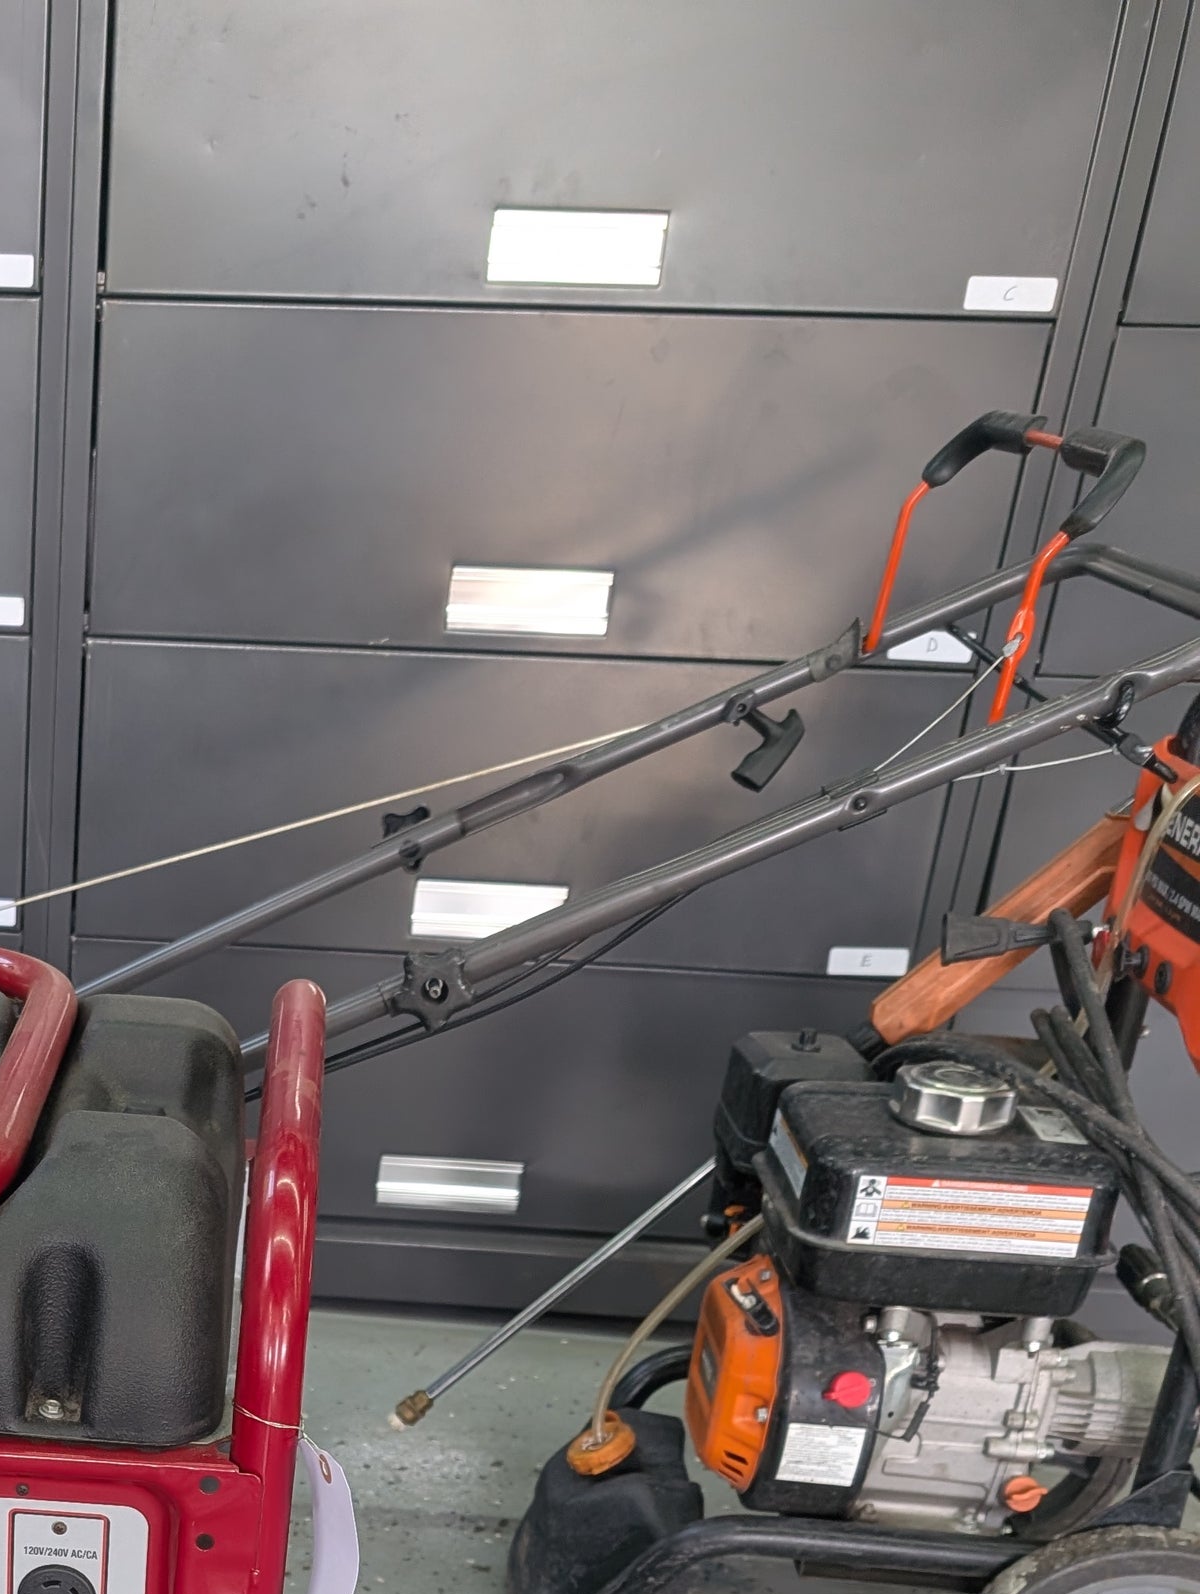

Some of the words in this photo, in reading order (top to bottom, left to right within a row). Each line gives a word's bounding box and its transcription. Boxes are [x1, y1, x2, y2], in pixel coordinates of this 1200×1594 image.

[1003, 285, 1018, 302] C
[926, 637, 938, 652] D
[860, 953, 873, 968] E
[24, 1546, 68, 1558] 120V/240V
[70, 1550, 98, 1560] AC/CA
